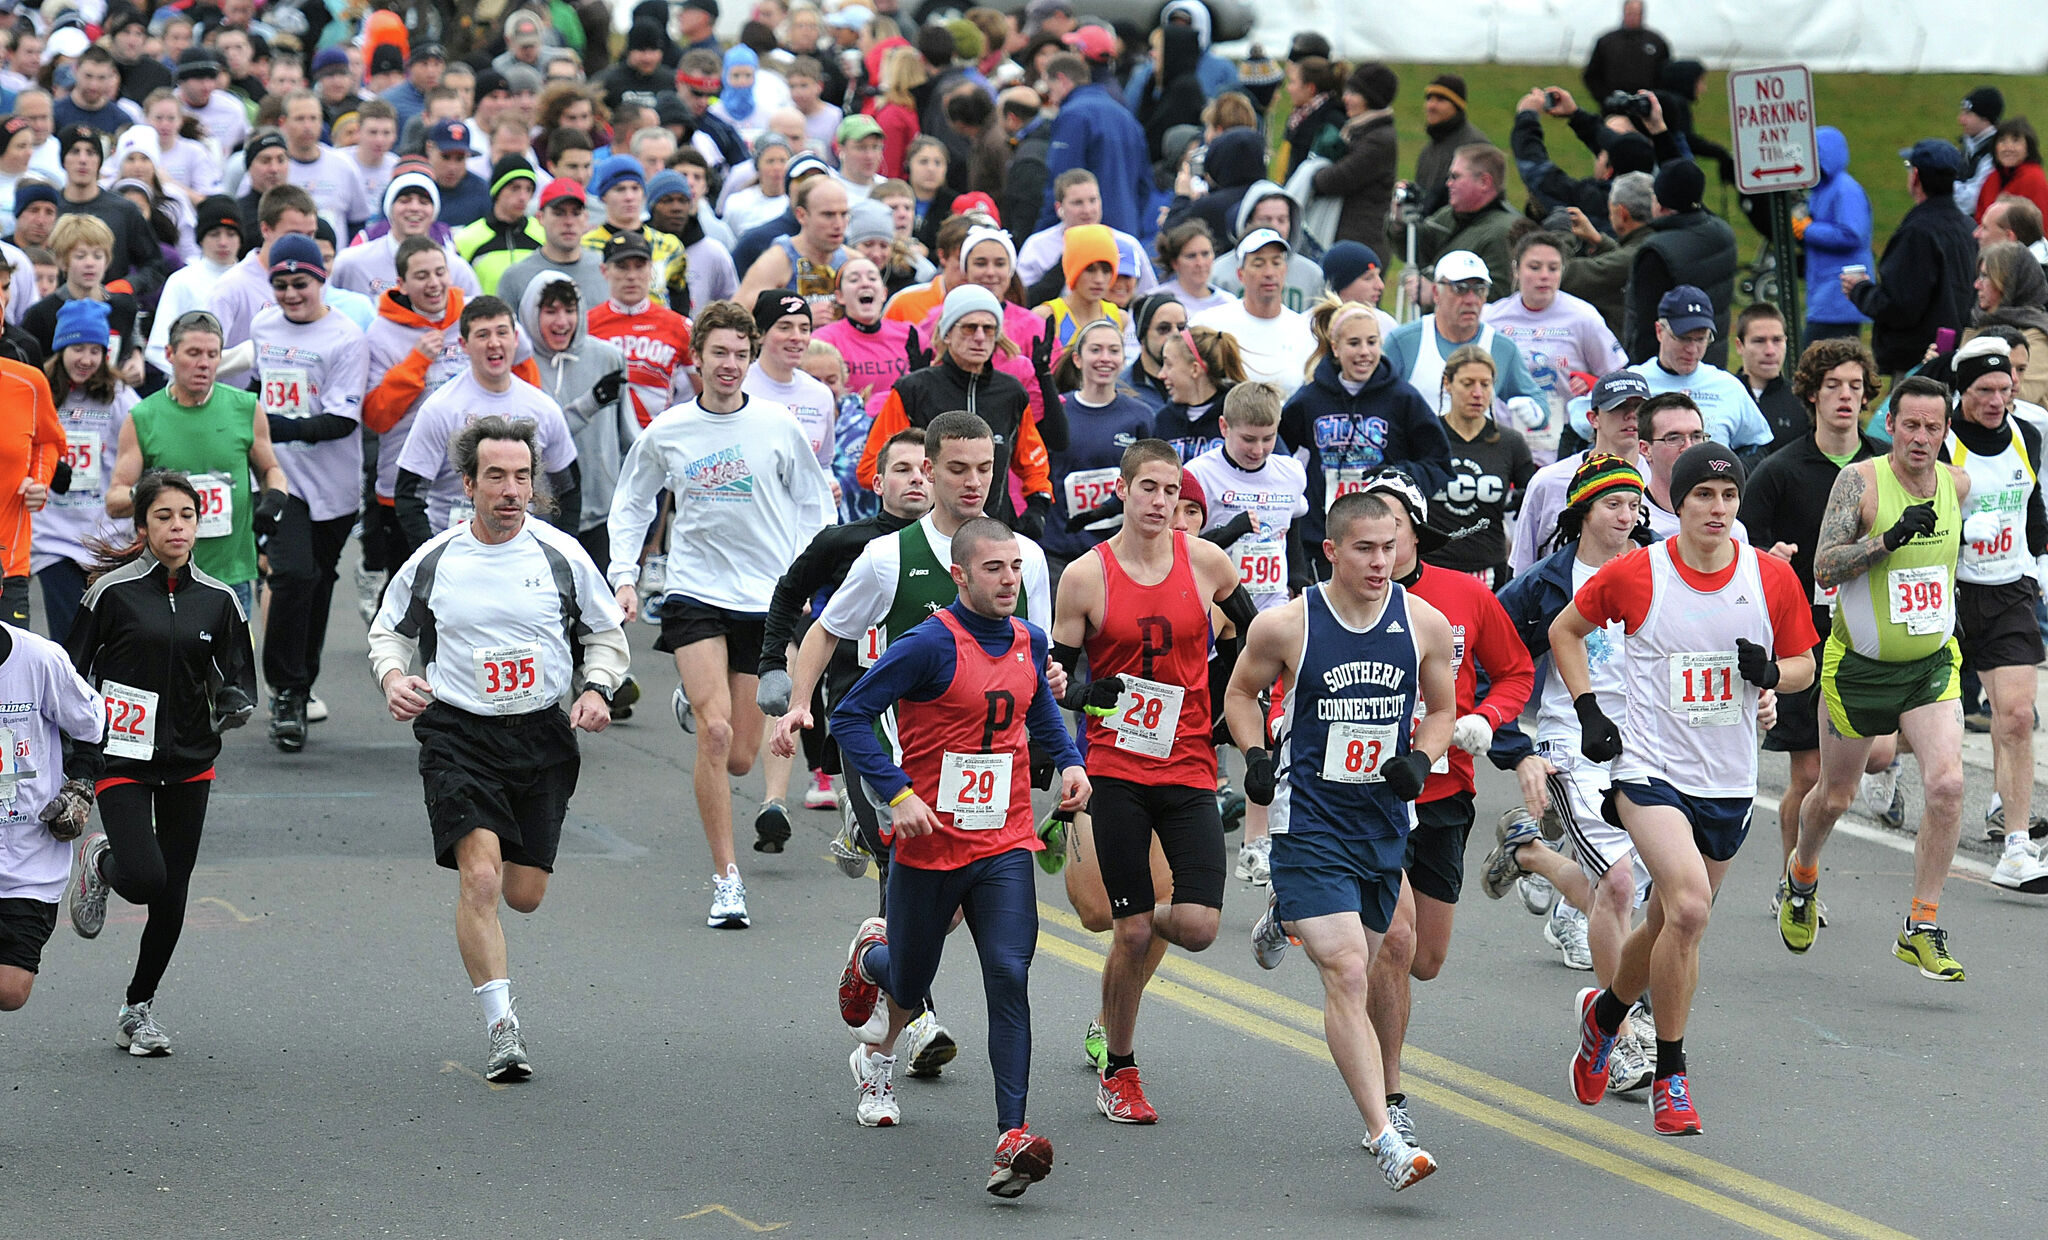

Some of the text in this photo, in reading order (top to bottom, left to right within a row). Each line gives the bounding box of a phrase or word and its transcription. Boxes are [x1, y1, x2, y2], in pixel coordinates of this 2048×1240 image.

[1756, 77, 1785, 101] NO
[1738, 99, 1808, 128] PARKING
[1760, 127, 1790, 145] ANY
[266, 382, 300, 407] 634
[1709, 459, 1732, 472] VT
[1240, 555, 1281, 584] 596
[1898, 581, 1942, 613] 398
[1137, 615, 1173, 683] P
[483, 656, 536, 694] 335
[1323, 661, 1406, 693] SOUTHERN
[1682, 667, 1733, 703] 111
[0, 701, 33, 713] aines
[3, 714, 28, 724] Business
[104, 697, 145, 736] 522
[983, 690, 1015, 753] P
[1123, 692, 1163, 730] 28
[1318, 694, 1406, 721] CONNECTICUT
[15, 738, 30, 757] 5K
[1345, 740, 1382, 773] 83
[958, 770, 995, 804] 29
